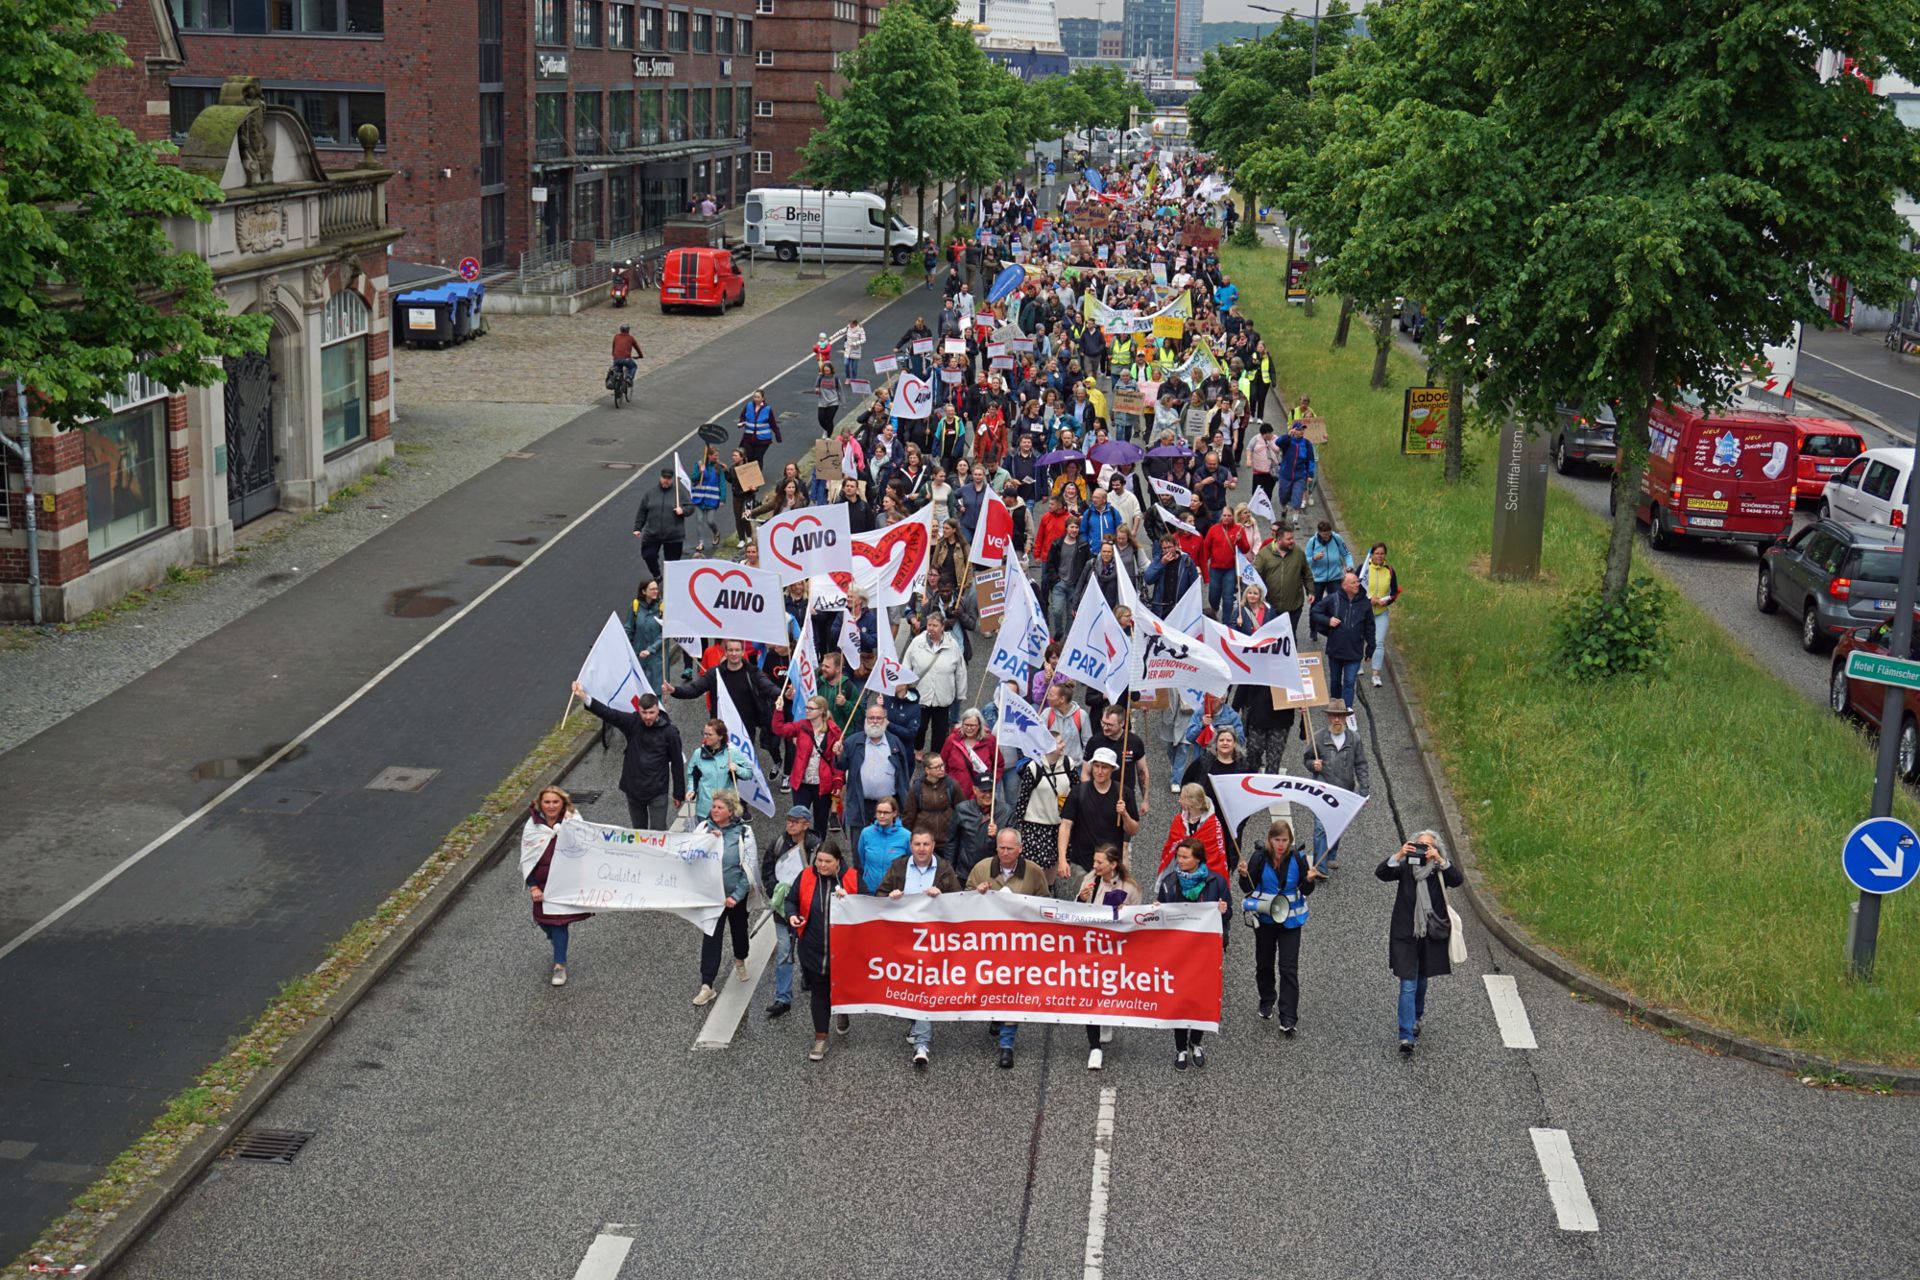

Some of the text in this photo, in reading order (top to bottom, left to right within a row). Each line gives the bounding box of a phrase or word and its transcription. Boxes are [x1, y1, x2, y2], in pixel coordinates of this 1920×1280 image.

[786, 206, 821, 222] Brehe
[1412, 391, 1449, 403] Laboe
[1688, 499, 1728, 509] BIRKHAHN
[791, 528, 836, 556] AWO
[977, 573, 992, 582] Wenn
[713, 588, 764, 613] AWO
[813, 595, 848, 610] AWO
[1242, 636, 1291, 657] AWO
[1148, 659, 1200, 673] JUGENDWERK
[1158, 669, 1175, 679] AWO
[1853, 660, 1920, 681] Hotel Flämischer
[1272, 780, 1340, 808] AWO
[602, 830, 668, 848] Wirbelwind
[655, 874, 678, 889] statt
[1054, 911, 1070, 921] DER
[1142, 915, 1160, 923] AWO
[912, 927, 1128, 957] Zusammen für
[868, 957, 1176, 997] Soziale Gerechtigkeit
[885, 987, 1159, 1012] bedarfsgerecht gestalten, statt zu verwalten
